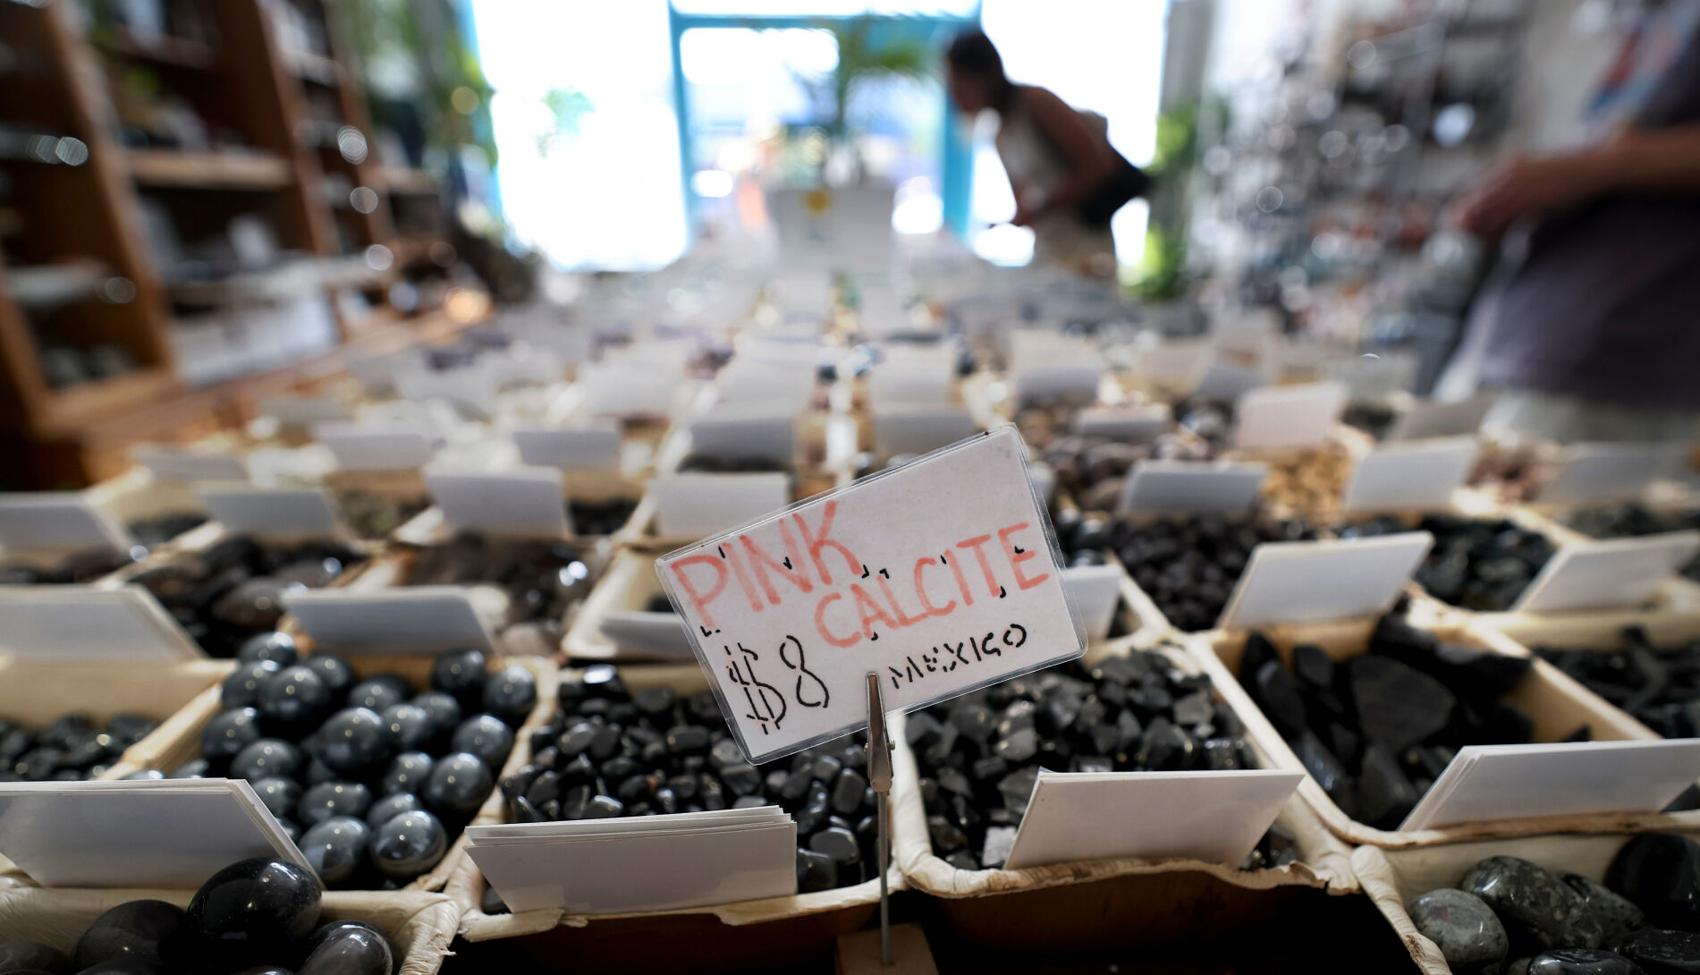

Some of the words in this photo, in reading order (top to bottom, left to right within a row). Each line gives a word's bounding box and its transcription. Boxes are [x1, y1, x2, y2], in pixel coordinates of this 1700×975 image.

[670, 500, 864, 631] PINK
[814, 523, 1050, 648] CALCITE
[724, 634, 830, 735] $8
[889, 623, 1028, 690] MEXICO
